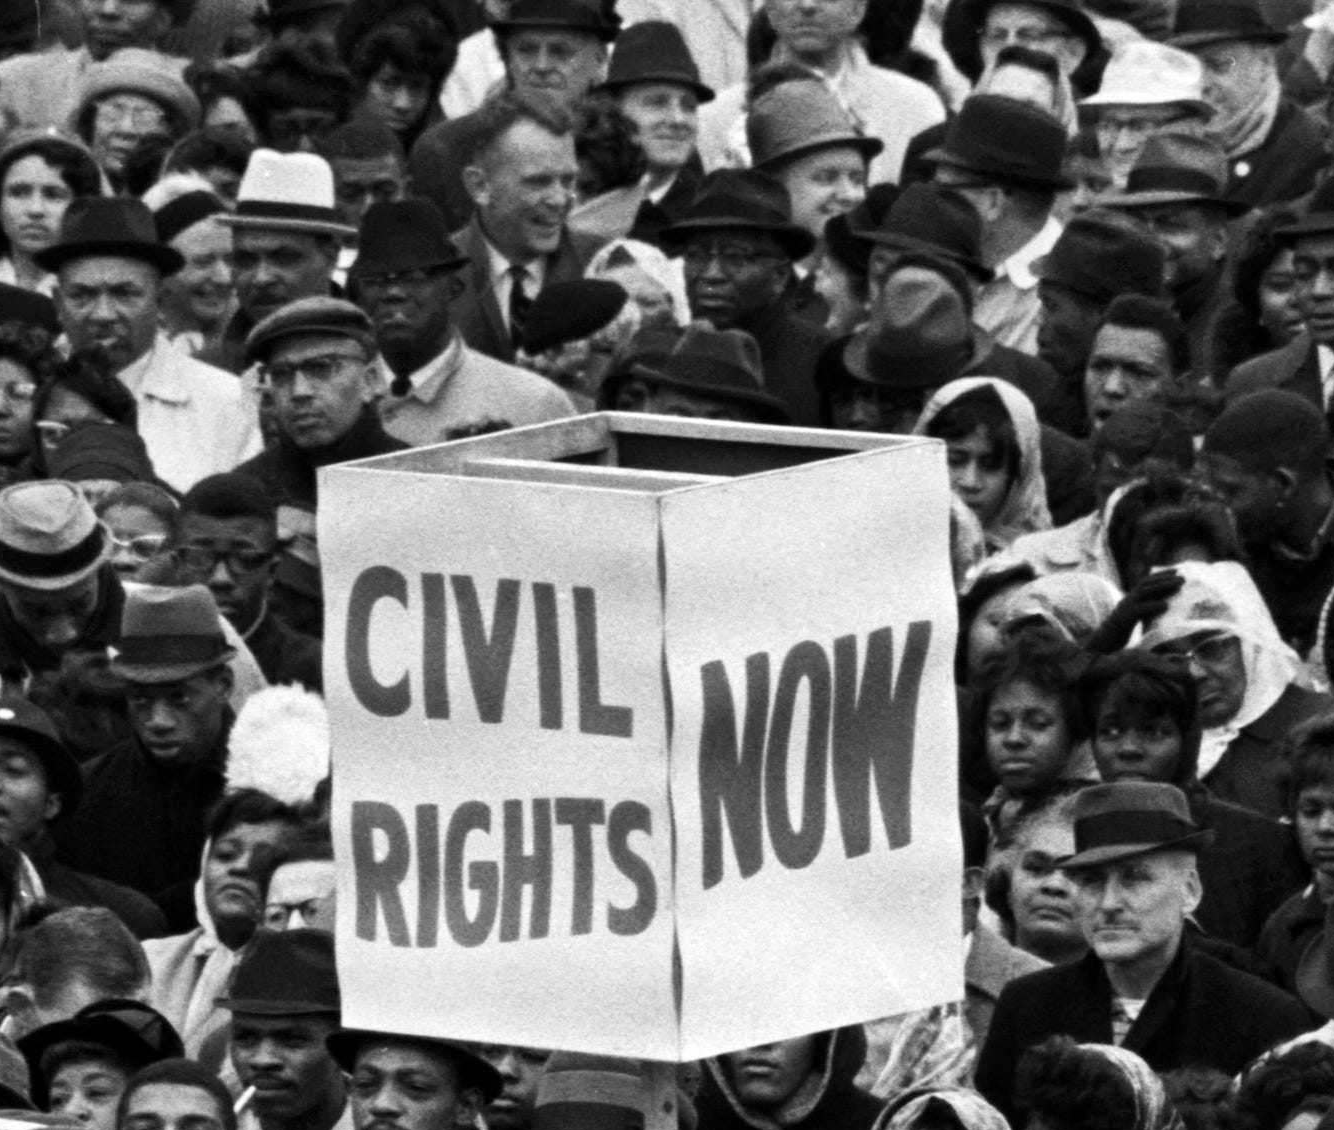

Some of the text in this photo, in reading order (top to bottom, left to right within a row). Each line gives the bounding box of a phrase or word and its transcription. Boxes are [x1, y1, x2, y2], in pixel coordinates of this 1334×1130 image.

[345, 565, 633, 738] CIVIL
[698, 620, 933, 890] NOW
[351, 797, 658, 948] RIGHTS
